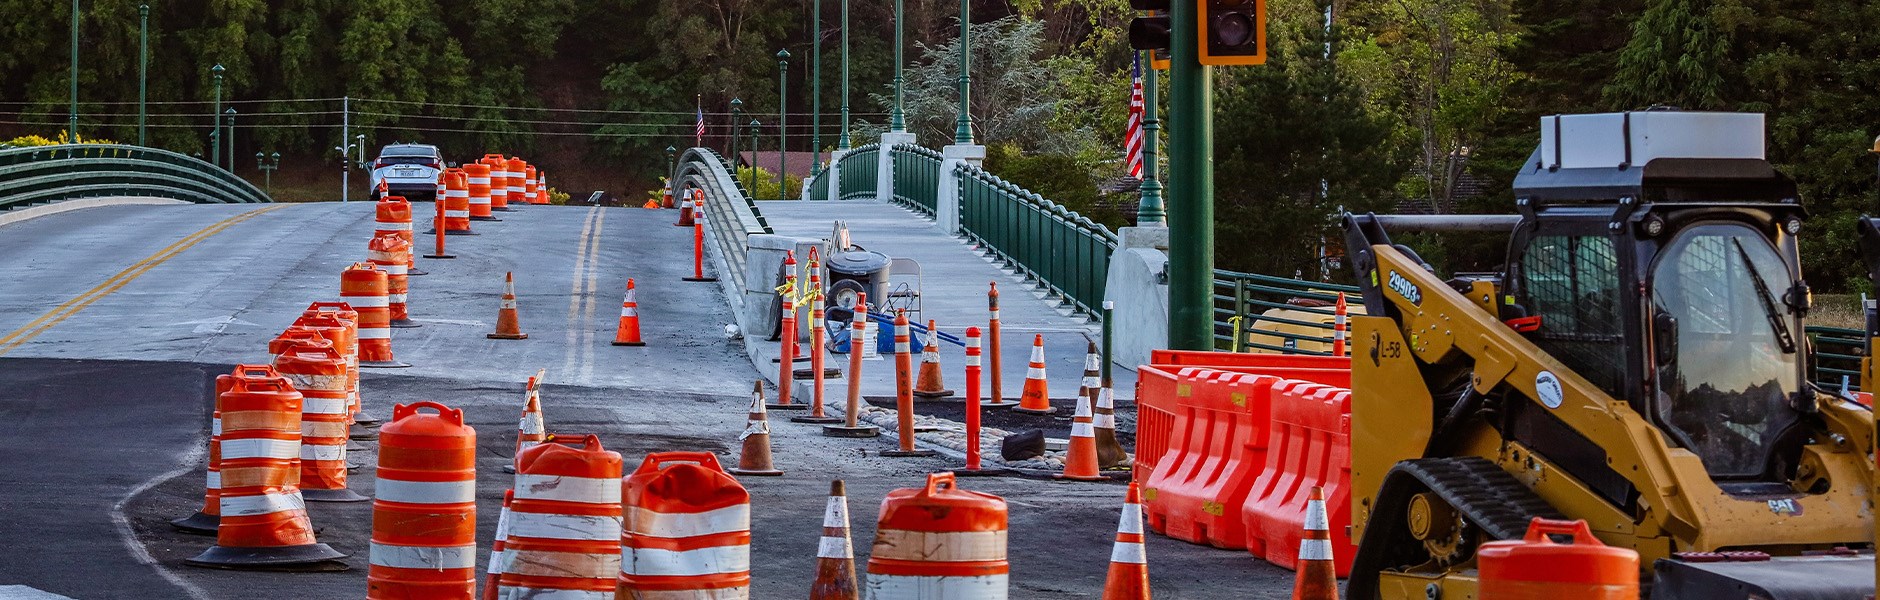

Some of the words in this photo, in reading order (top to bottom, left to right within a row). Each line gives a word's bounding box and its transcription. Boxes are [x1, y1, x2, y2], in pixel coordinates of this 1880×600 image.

[1388, 270, 1417, 303] 299D3
[1381, 341, 1401, 358] L-58
[1767, 498, 1795, 512] CAT
